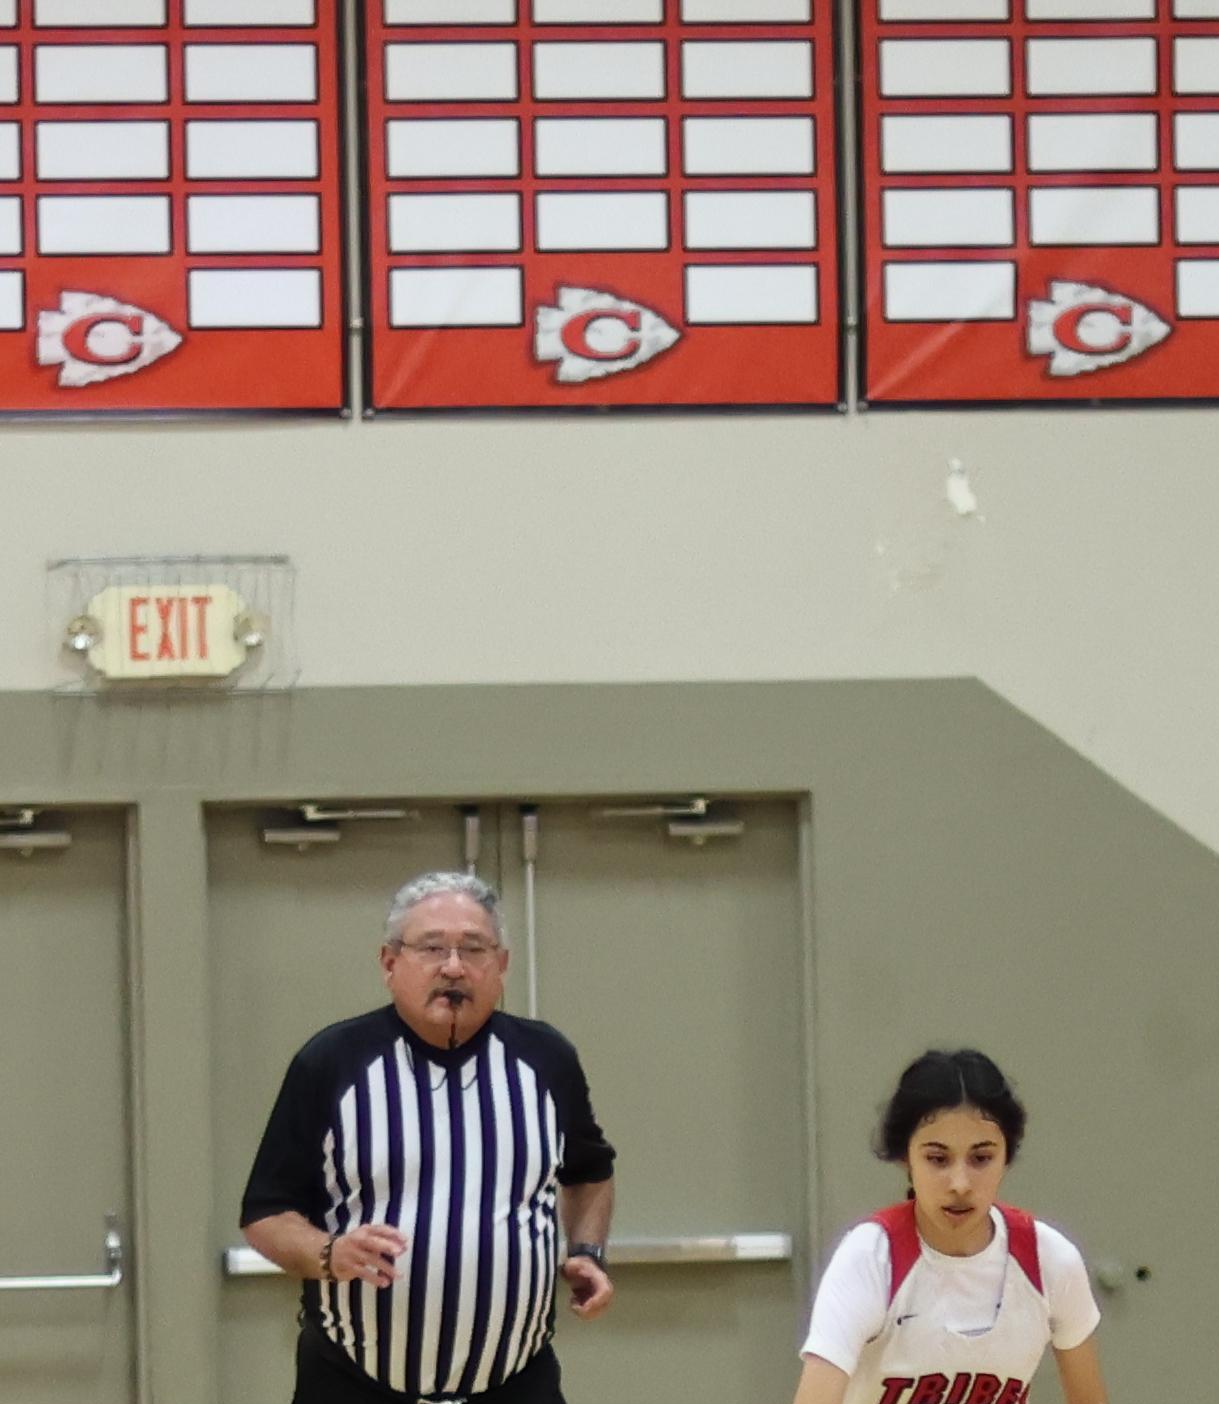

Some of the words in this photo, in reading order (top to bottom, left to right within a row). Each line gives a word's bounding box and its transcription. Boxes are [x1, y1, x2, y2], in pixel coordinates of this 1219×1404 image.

[61, 312, 144, 366] C
[560, 308, 641, 362] C
[1052, 301, 1133, 355] C
[128, 596, 213, 662] EXIT
